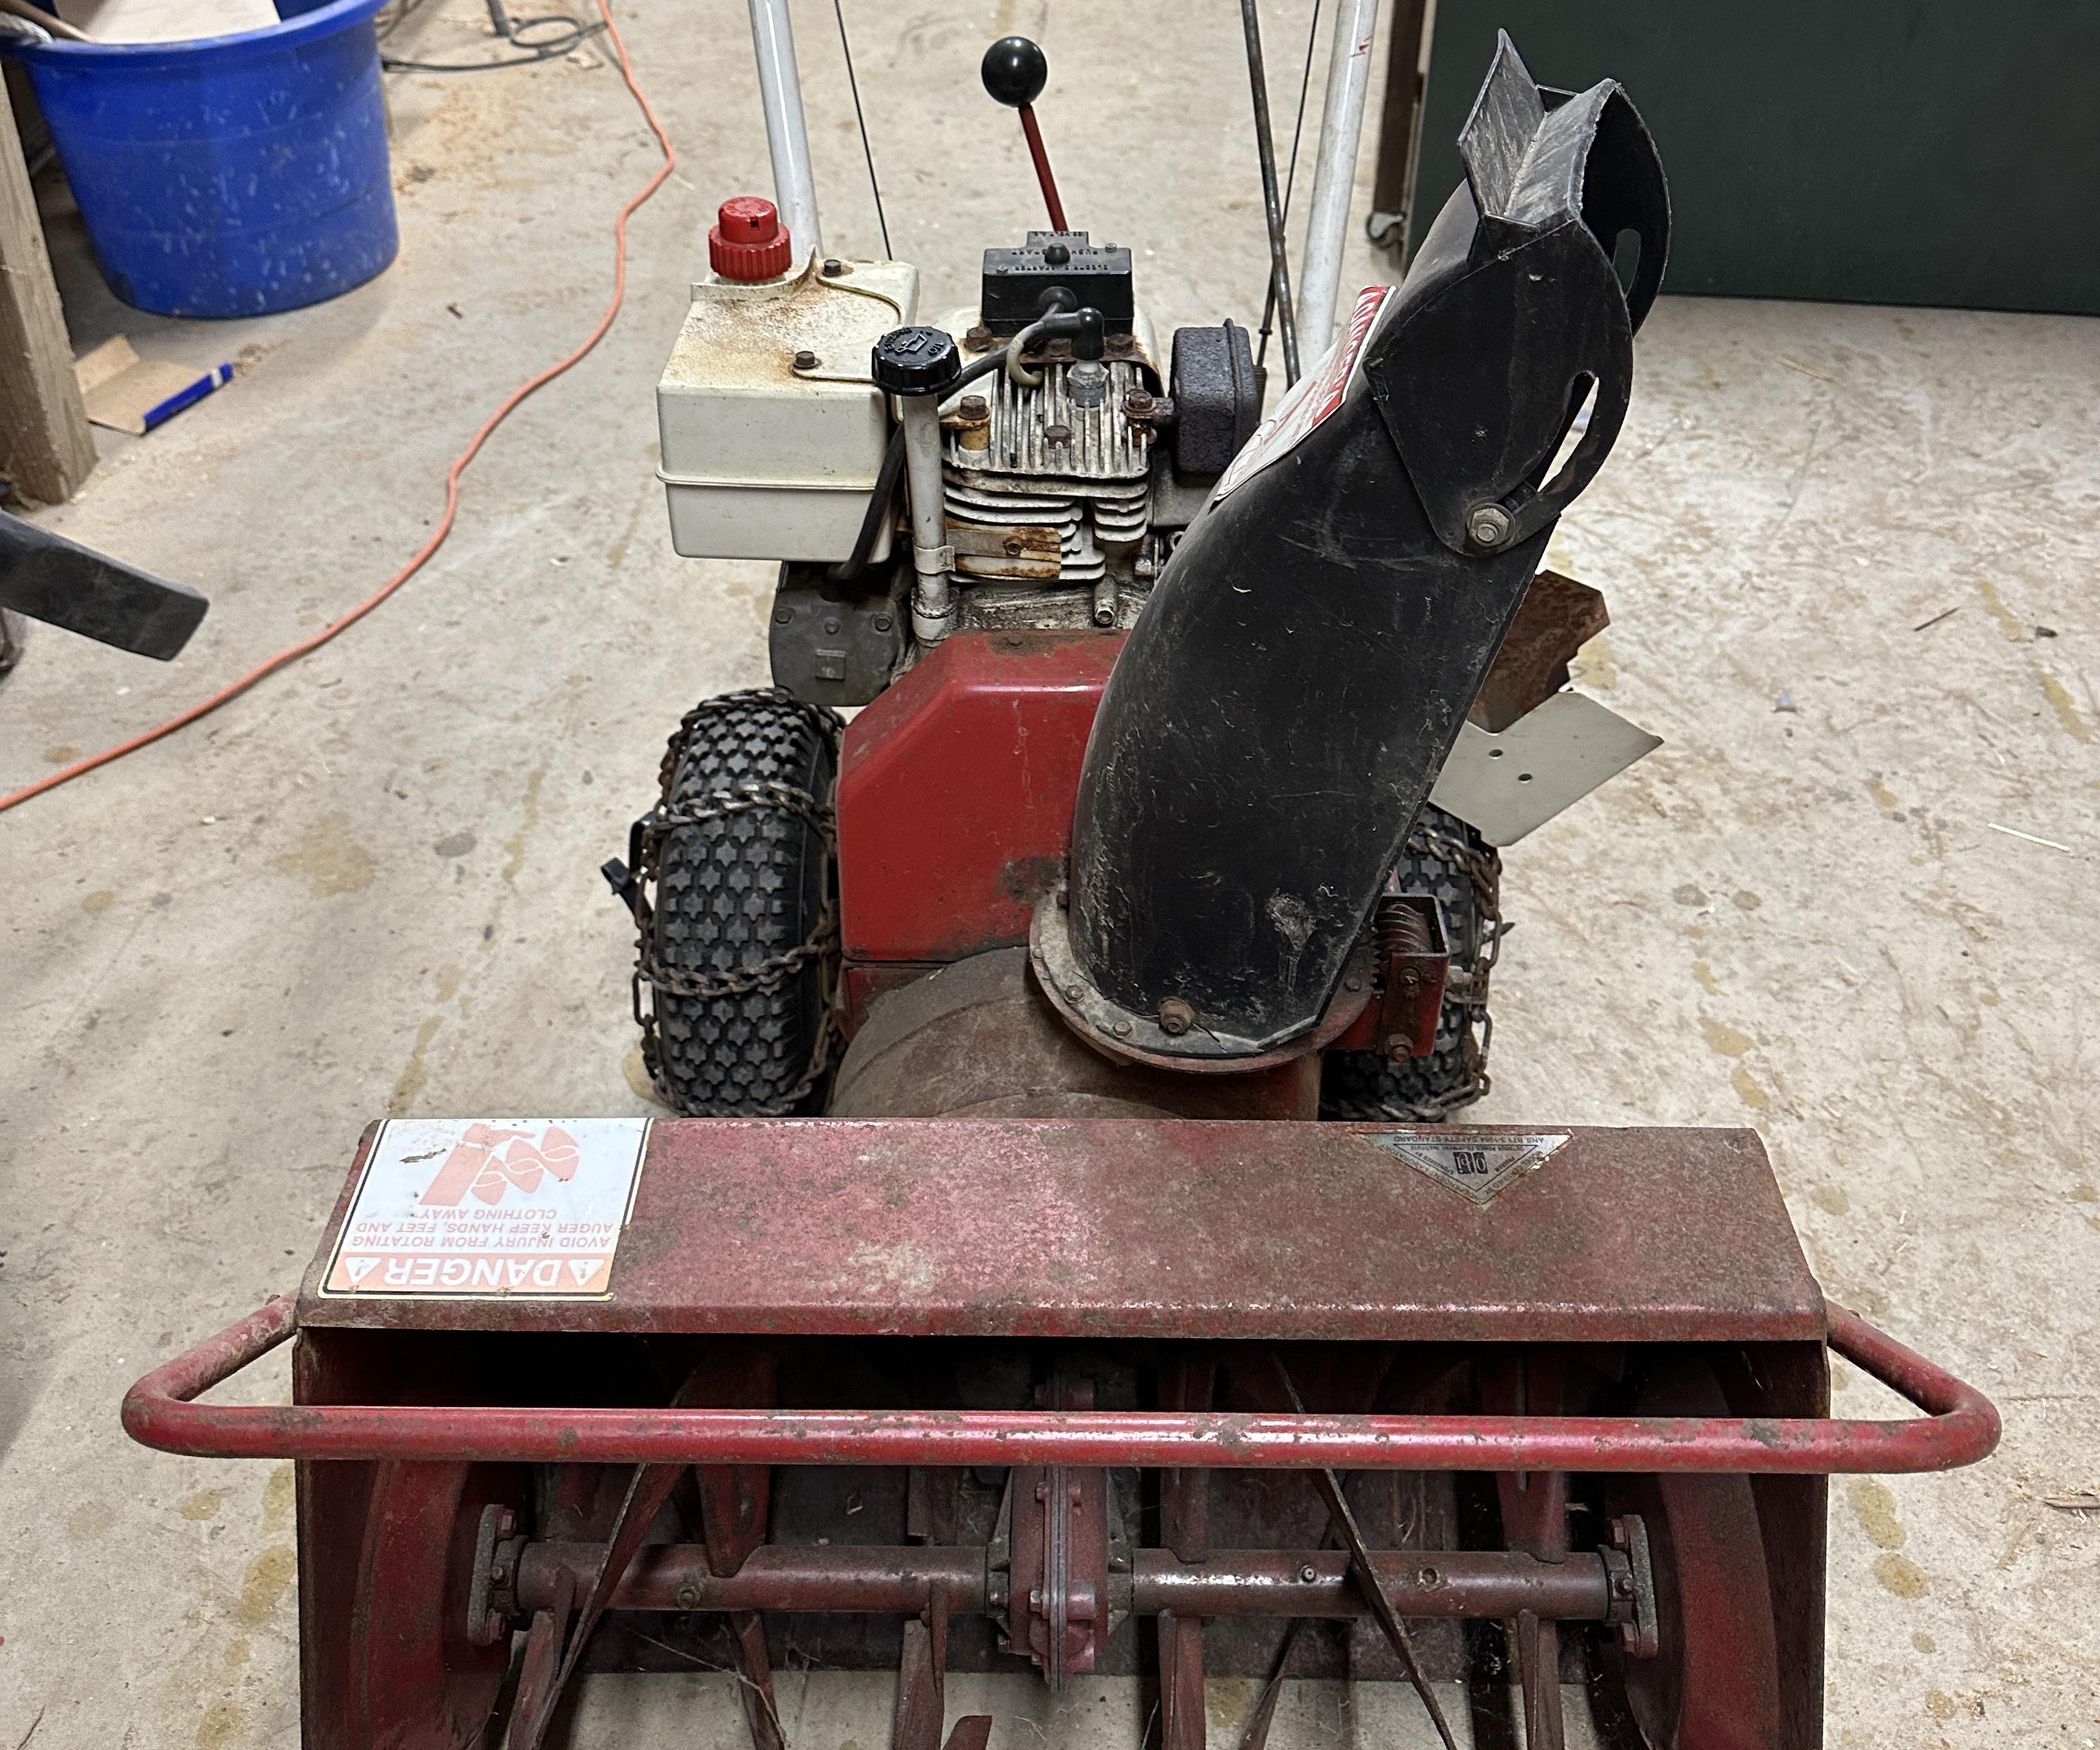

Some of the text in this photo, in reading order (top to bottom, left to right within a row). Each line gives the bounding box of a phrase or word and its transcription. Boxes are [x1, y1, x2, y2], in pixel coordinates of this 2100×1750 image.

[928, 342, 945, 356] OIL
[422, 1208, 557, 1220] CLOTHING AWAY
[356, 1221, 613, 1234] AUGER KEEP HANDS, FEET AND
[352, 1235, 611, 1248] AVOID INJURY FROM ROTATING
[384, 1257, 562, 1286] DANGER
